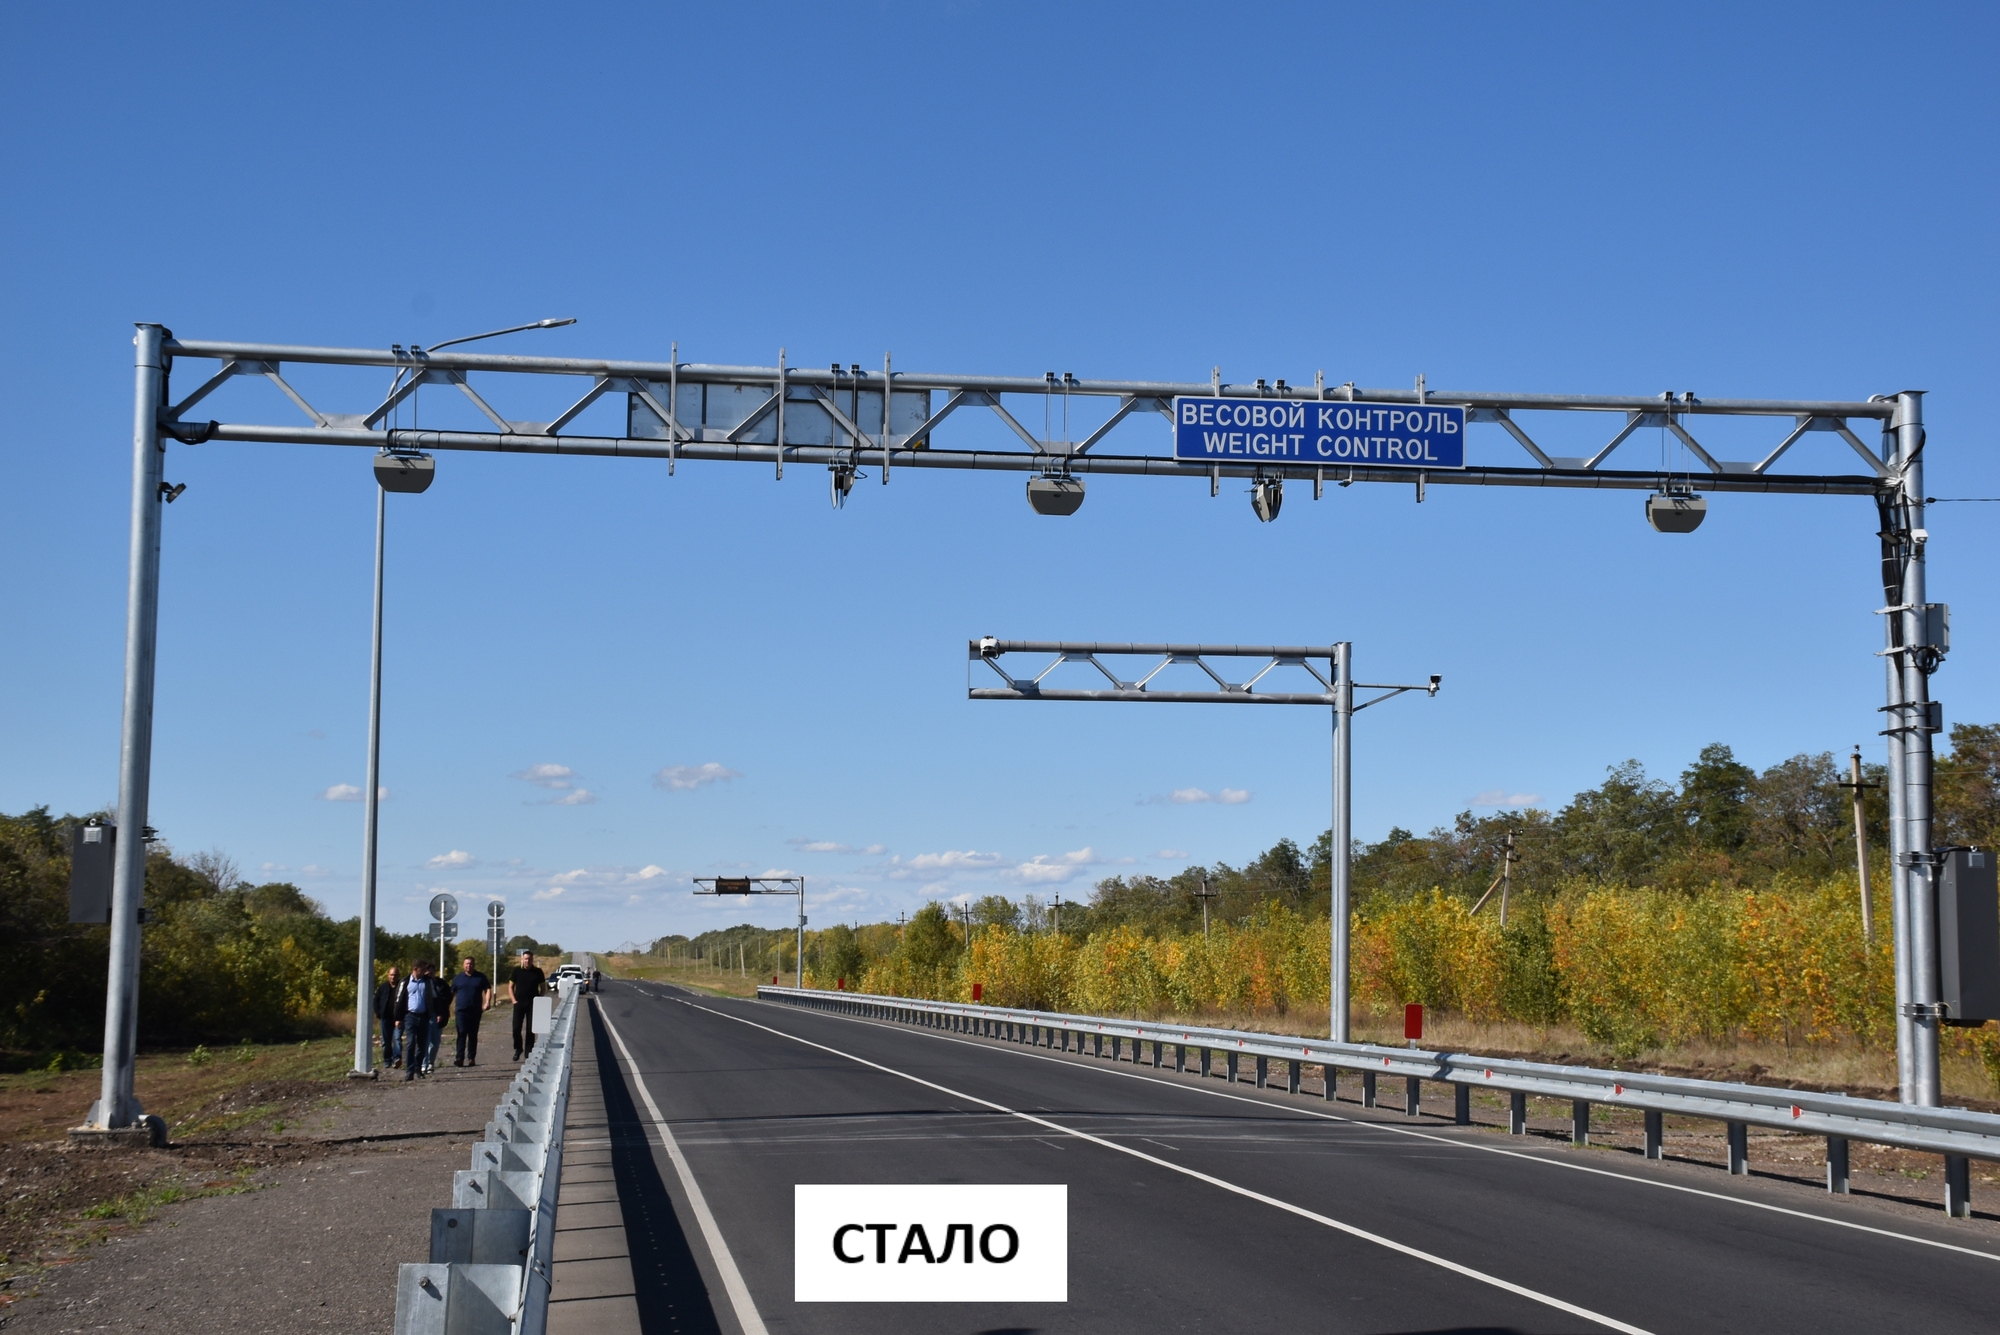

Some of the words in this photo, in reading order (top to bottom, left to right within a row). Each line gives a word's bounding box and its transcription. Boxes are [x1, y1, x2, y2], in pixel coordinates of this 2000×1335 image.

[1182, 401, 1305, 428] ВЕСОВОЙ
[1318, 408, 1459, 434] КОНТРОЛЬ
[1203, 431, 1305, 456] WEIGHT
[1316, 435, 1438, 461] CONTROL
